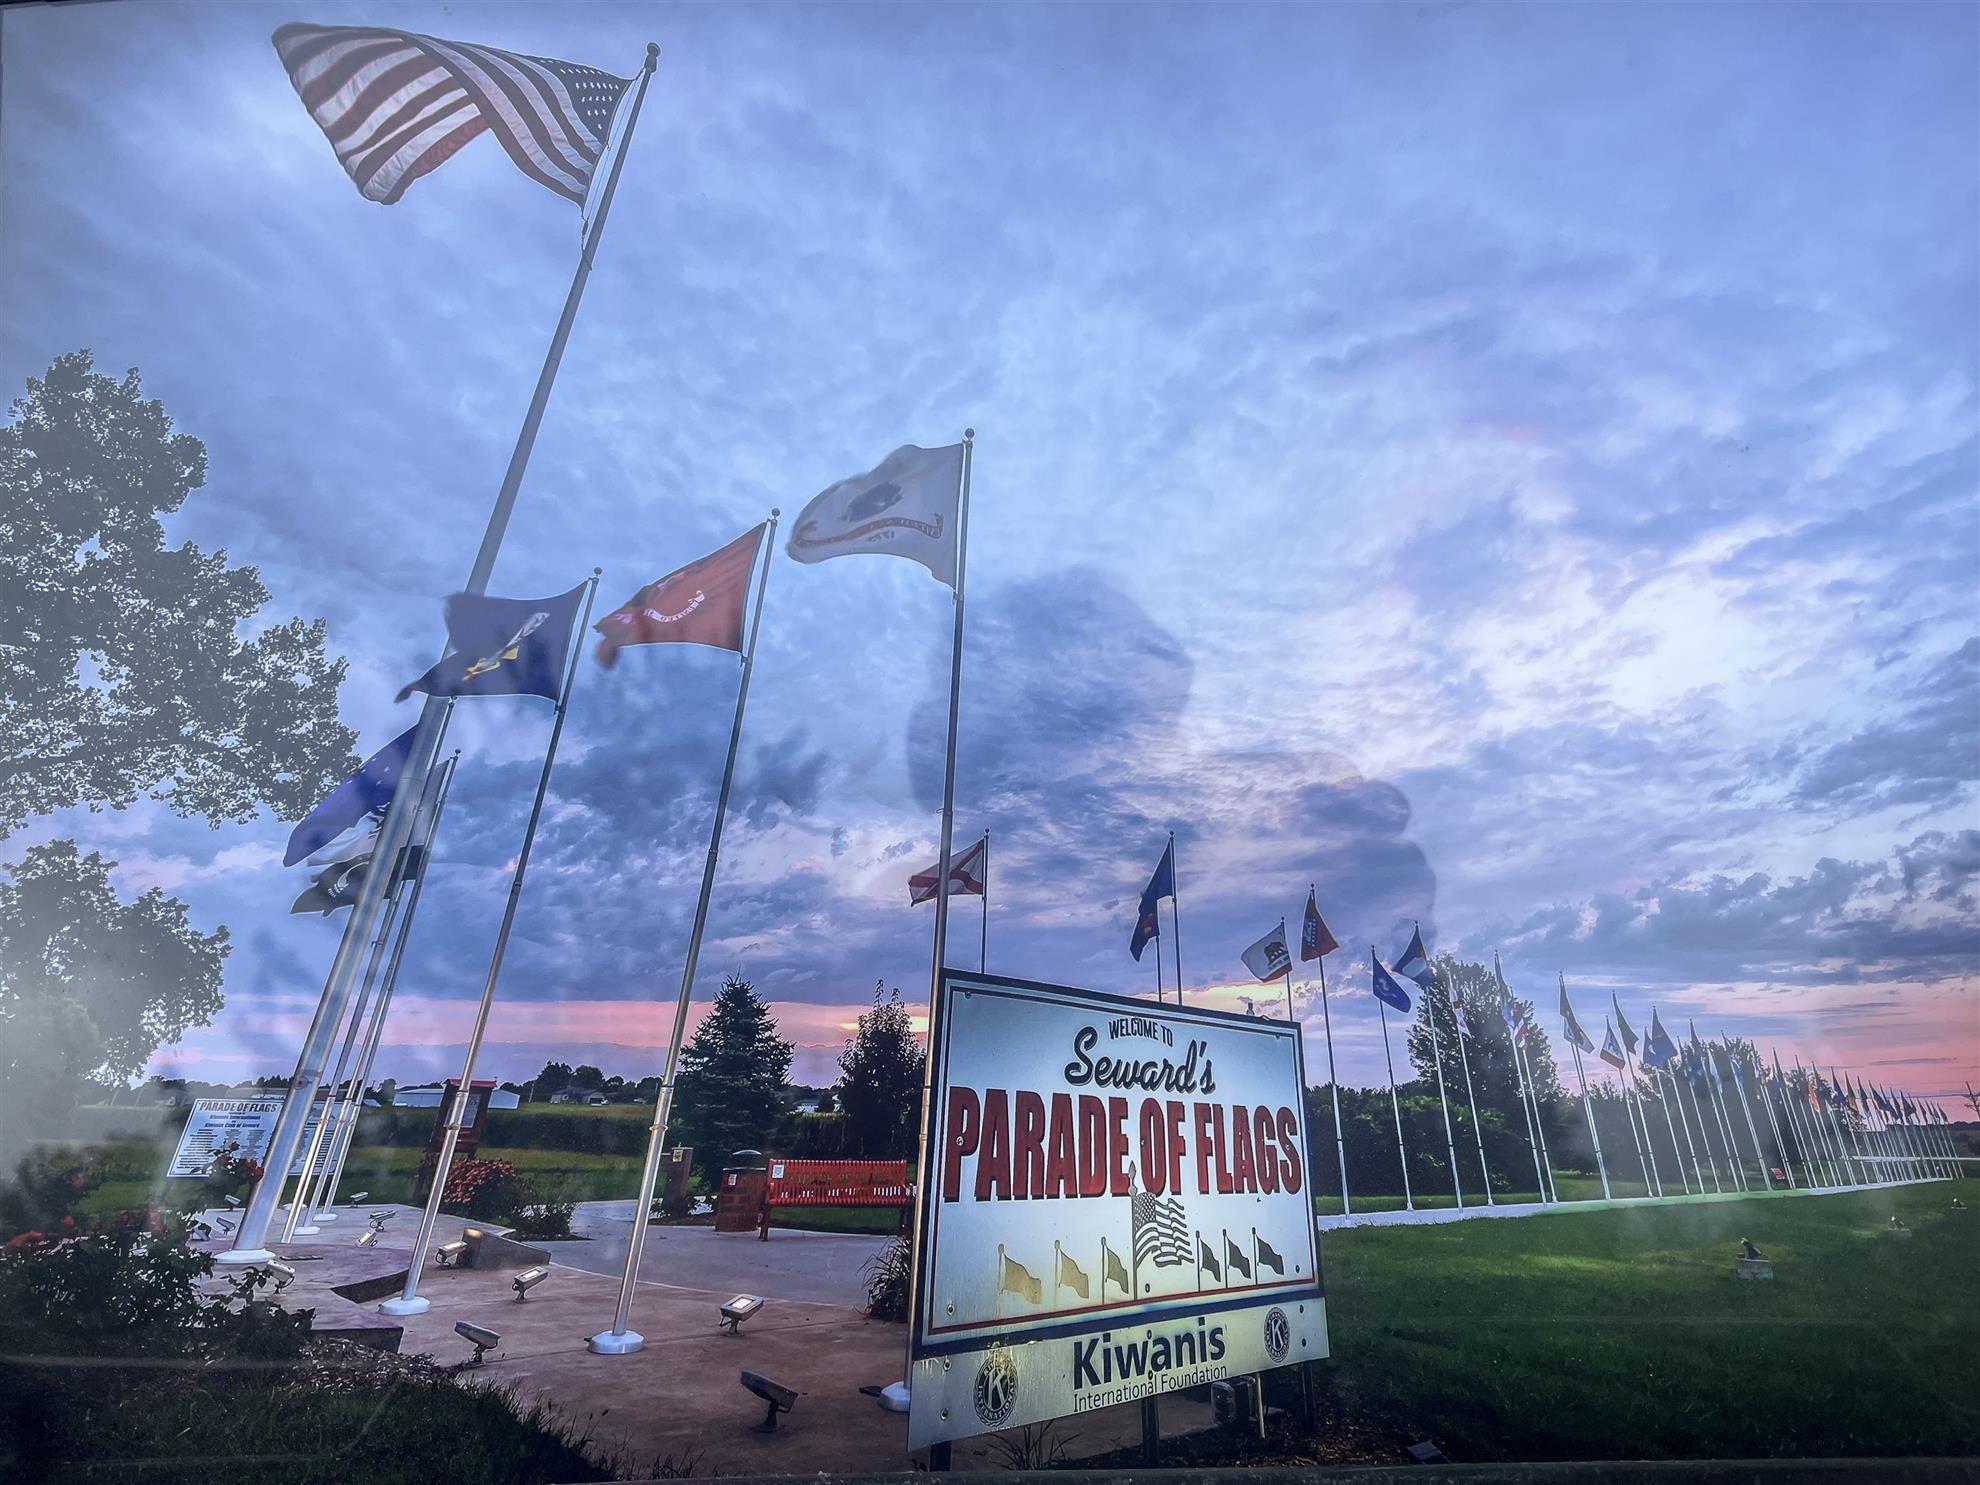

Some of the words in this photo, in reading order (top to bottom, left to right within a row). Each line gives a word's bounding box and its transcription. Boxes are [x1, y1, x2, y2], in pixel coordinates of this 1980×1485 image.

[1108, 1018, 1159, 1040] WELCOME
[1160, 1025, 1174, 1047] TO
[1065, 1026, 1216, 1095] Seward's
[199, 1102, 236, 1111] PARADE
[237, 1103, 250, 1112] OF
[249, 1103, 278, 1112] FLAGS
[943, 1086, 1130, 1202] PARADE
[1140, 1098, 1186, 1197] OF
[1194, 1102, 1302, 1195] FLAGS
[1073, 1317, 1226, 1390] Kiwanis
[1271, 1318, 1284, 1350] K
[987, 1367, 1006, 1410] K
[1073, 1375, 1158, 1413] International
[1161, 1365, 1227, 1392] Foundation
